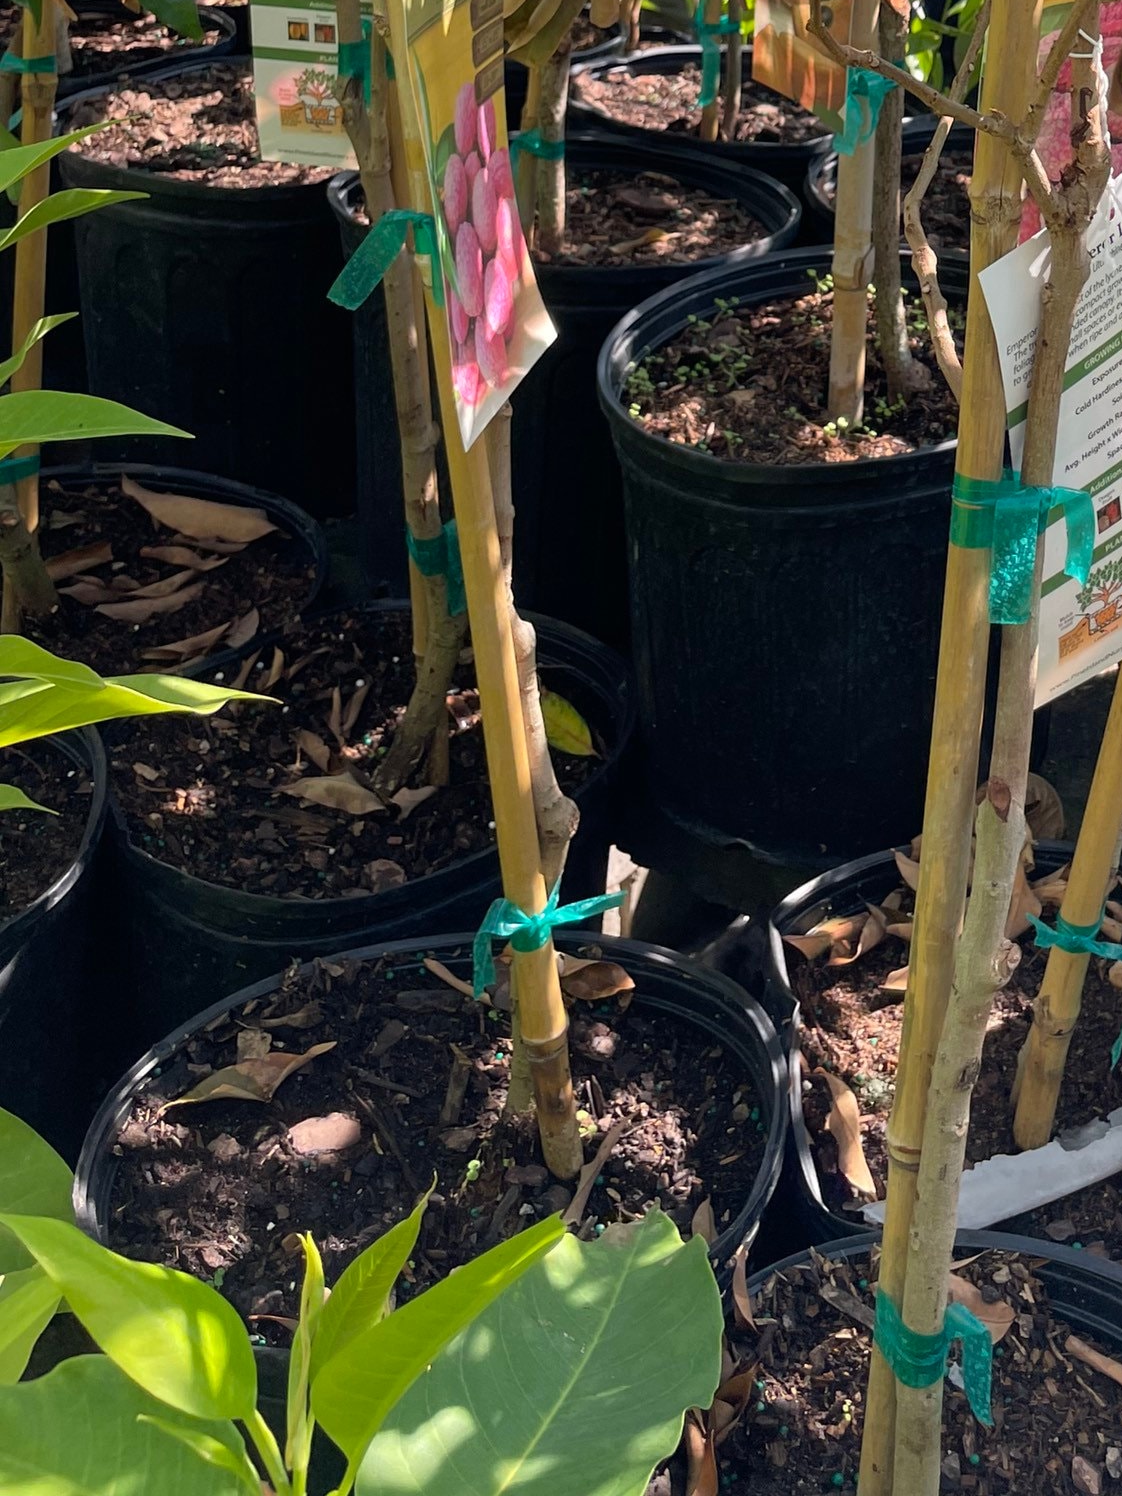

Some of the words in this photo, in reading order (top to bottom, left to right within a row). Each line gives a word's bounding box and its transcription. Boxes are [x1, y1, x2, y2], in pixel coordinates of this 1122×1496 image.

[1013, 353, 1035, 375] foliag
[1084, 339, 1120, 369] GROWING
[1092, 359, 1122, 386] Exposure
[1075, 399, 1091, 415] Cold
[1087, 418, 1113, 440] Growth
[1064, 459, 1079, 473] Avg.
[1081, 439, 1106, 461] Height
